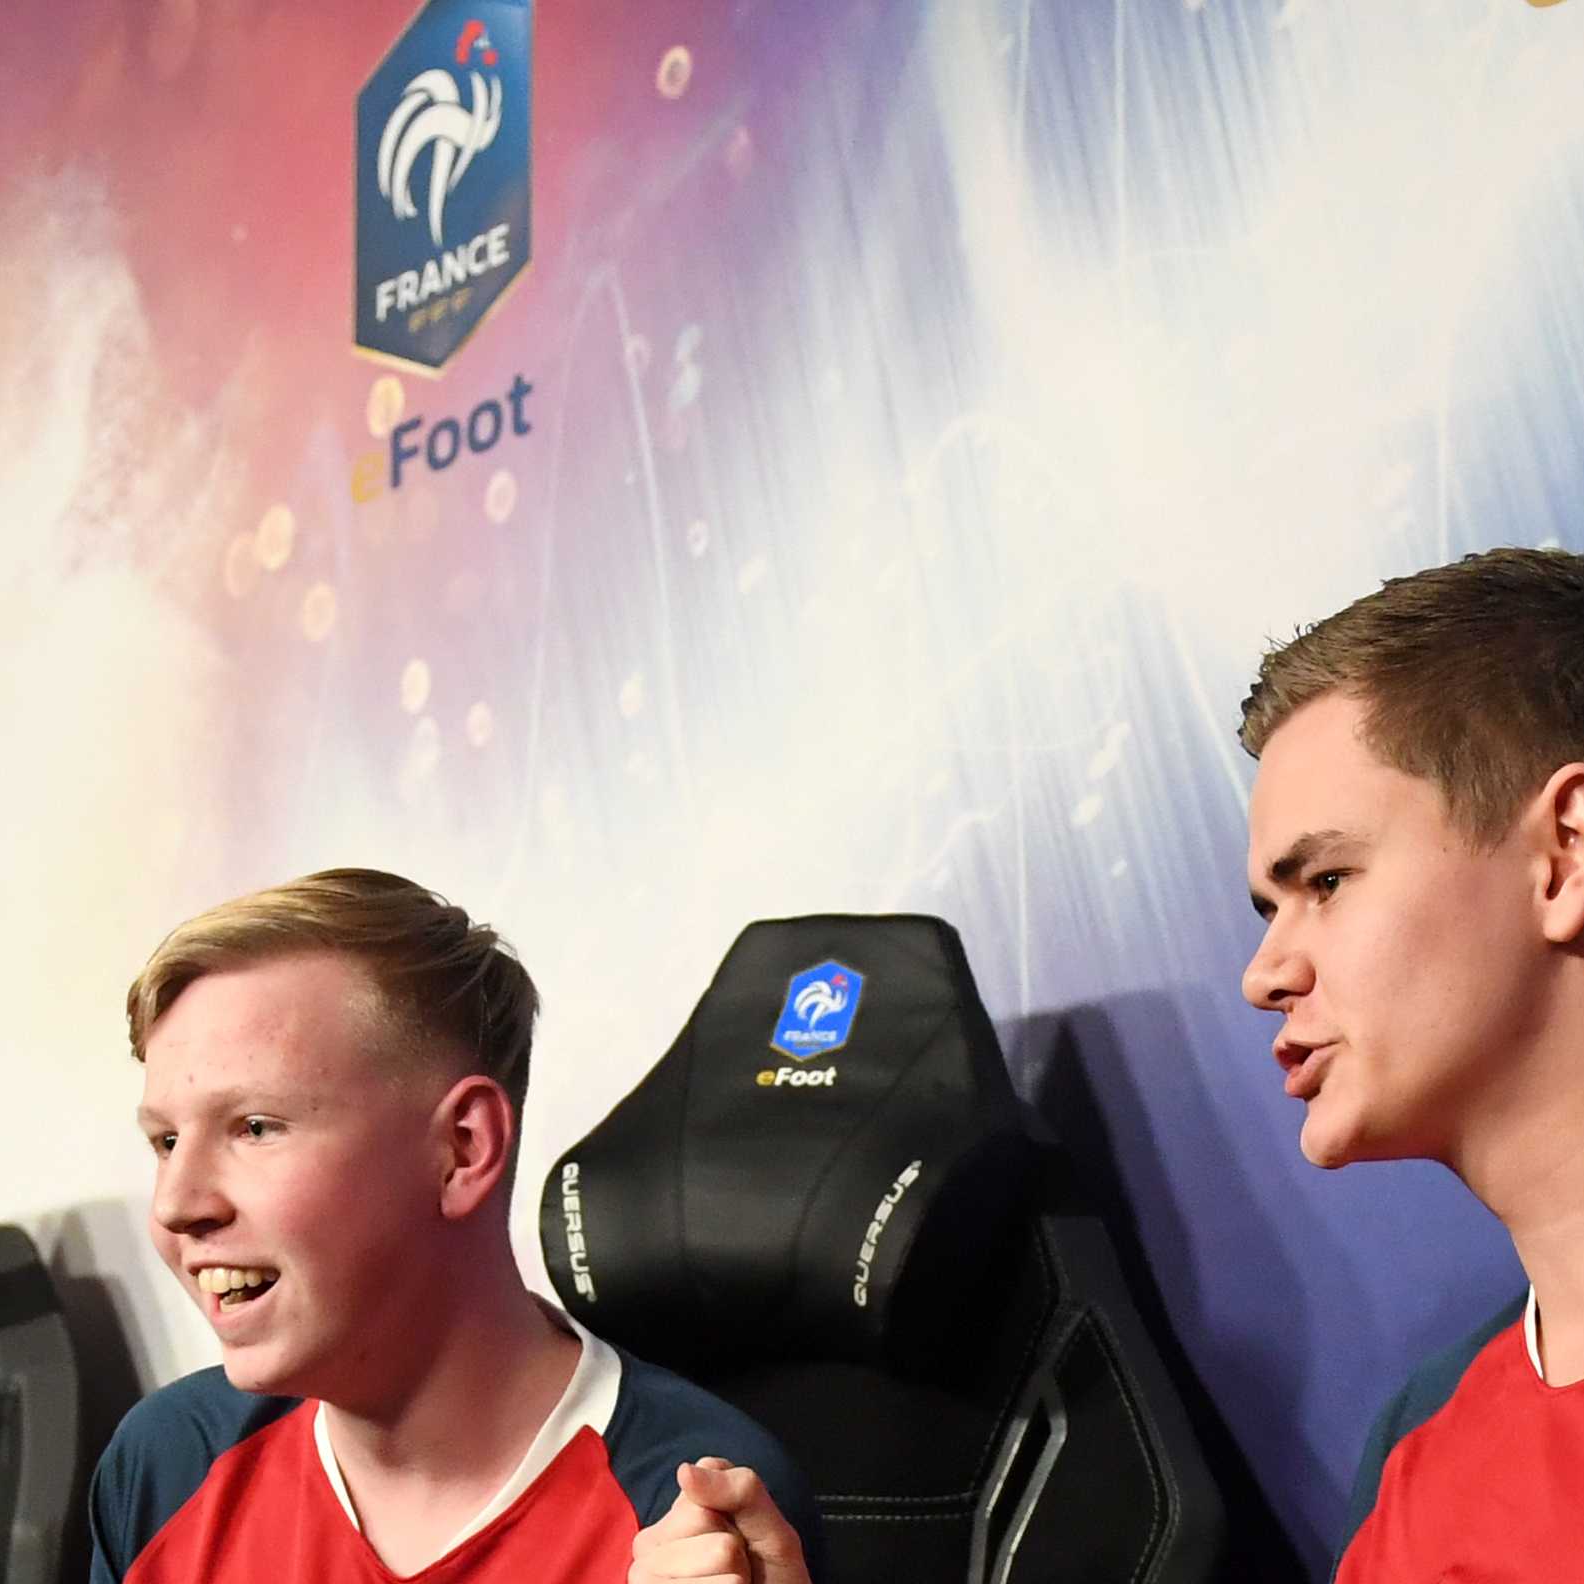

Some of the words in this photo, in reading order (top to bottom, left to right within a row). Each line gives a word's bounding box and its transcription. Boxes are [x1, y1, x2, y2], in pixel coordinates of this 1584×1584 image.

[375, 223, 511, 322] FRANCE
[351, 372, 533, 504] eFoot
[756, 1066, 837, 1087] eFoot
